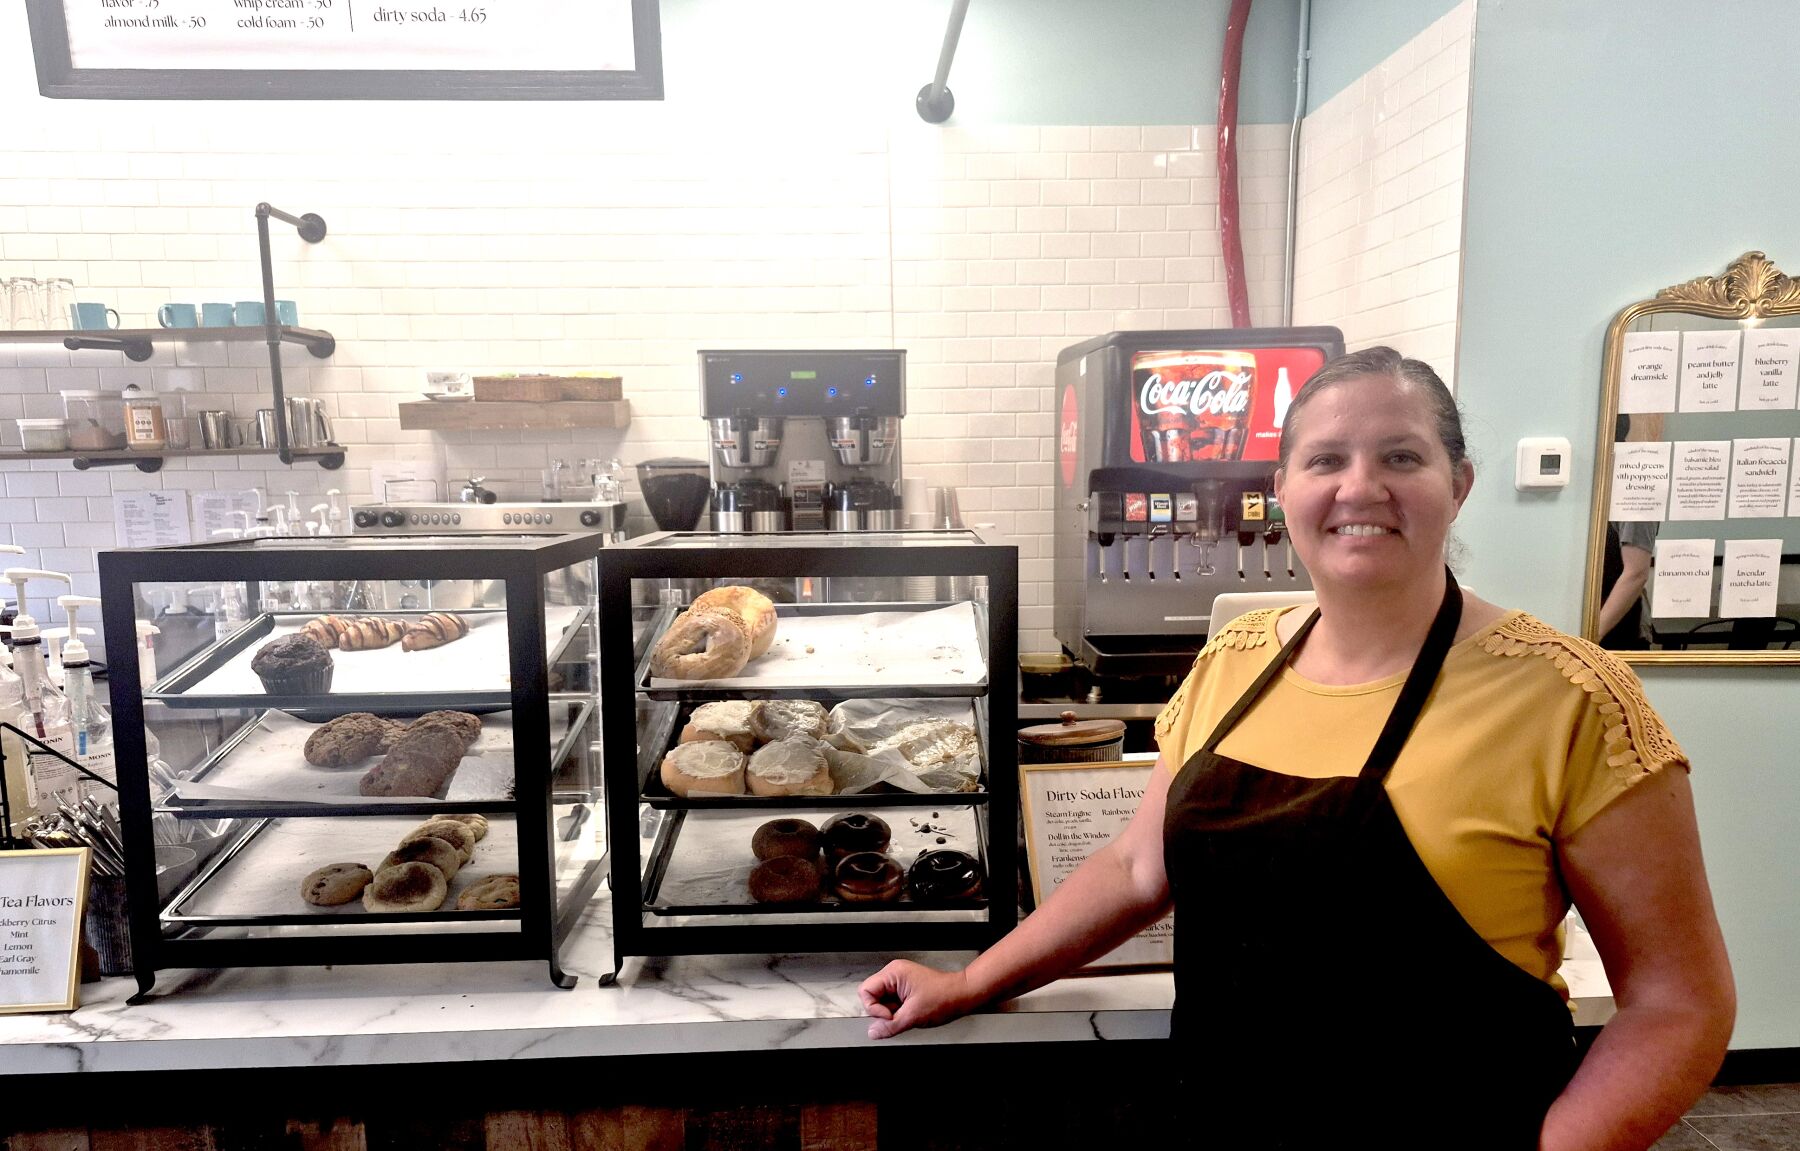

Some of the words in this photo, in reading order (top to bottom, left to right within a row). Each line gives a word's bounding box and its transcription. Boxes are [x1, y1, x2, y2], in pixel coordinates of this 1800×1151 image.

[233, 0, 262, 12] whip
[265, 0, 304, 8] cream
[373, 6, 408, 25] dirty
[410, 6, 446, 22] soda
[458, 7, 487, 24] 4.65
[104, 15, 150, 28] almond
[152, 15, 179, 28] milk
[188, 16, 207, 29] .50
[237, 15, 263, 28] cold
[265, 15, 296, 28] foam
[306, 16, 324, 29] .50
[1687, 361, 1712, 370] peanut
[1713, 360, 1735, 368] butter
[1754, 357, 1788, 366] blueberry
[1638, 363, 1663, 371] orange
[1696, 371, 1710, 379] and
[1709, 371, 1723, 380] jelly
[1140, 371, 1252, 415] Coca-Cola
[1736, 458, 1758, 466] italian
[1758, 457, 1787, 465] focaccia
[1641, 463, 1665, 471] greens
[1745, 468, 1777, 476] sandwich
[1625, 482, 1656, 492] dressing
[1658, 569, 1693, 577] cinnamon
[1756, 579, 1772, 587] latte
[40, 736, 64, 746] ONIN
[88, 752, 112, 761] MONIN
[1046, 790, 1078, 804] Dirty
[1080, 787, 1111, 801] Soda
[1068, 810, 1092, 819] Engine
[1101, 808, 1130, 816] Rainbow
[1048, 832, 1062, 840] Doll
[1070, 832, 1082, 840] the
[1082, 831, 1111, 839] Window
[0, 896, 23, 908] Tea
[25, 894, 74, 908] Flavors
[31, 918, 57, 926] Citrus
[10, 930, 29, 939] Mint
[4, 943, 33, 951] Lemon
[0, 954, 15, 964] Earl
[16, 955, 36, 964] Gray
